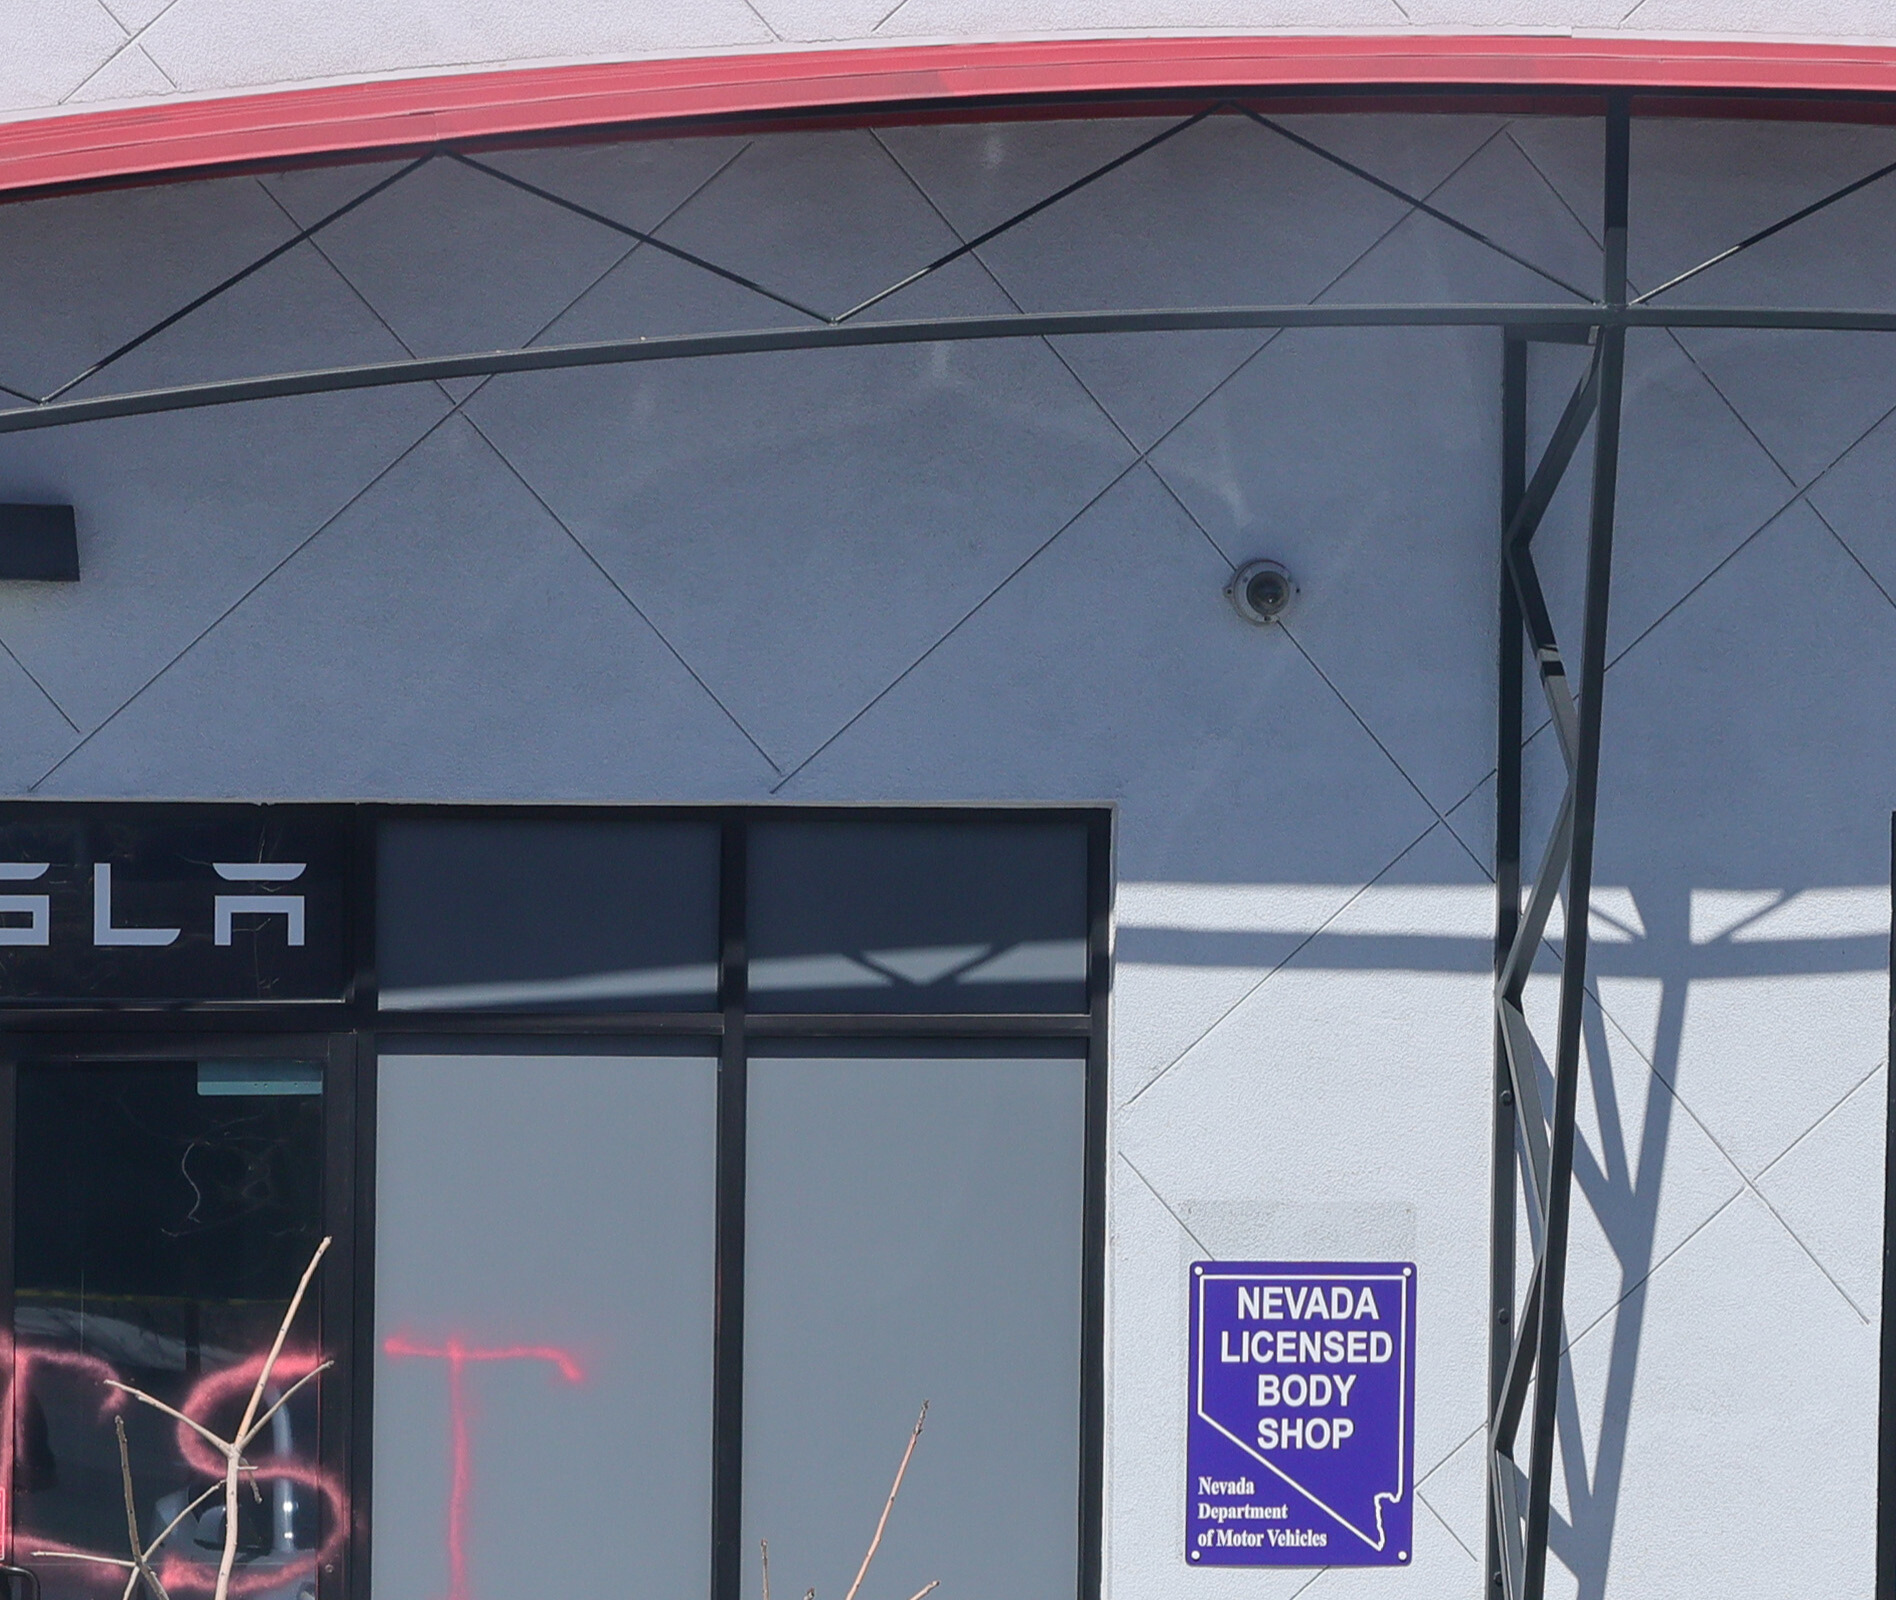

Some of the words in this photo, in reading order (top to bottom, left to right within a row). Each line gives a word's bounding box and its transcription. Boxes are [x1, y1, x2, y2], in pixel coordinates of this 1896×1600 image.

[1237, 1286, 1379, 1320] NEVADA
[1220, 1330, 1393, 1363] LICENSED
[1257, 1374, 1357, 1406] BODY
[1257, 1418, 1355, 1449] SHOP
[1198, 1477, 1255, 1495] Nevada
[1197, 1503, 1288, 1522] Department
[1197, 1529, 1214, 1547] of
[1216, 1529, 1264, 1546] Motor
[1267, 1529, 1327, 1547] Vehicles
